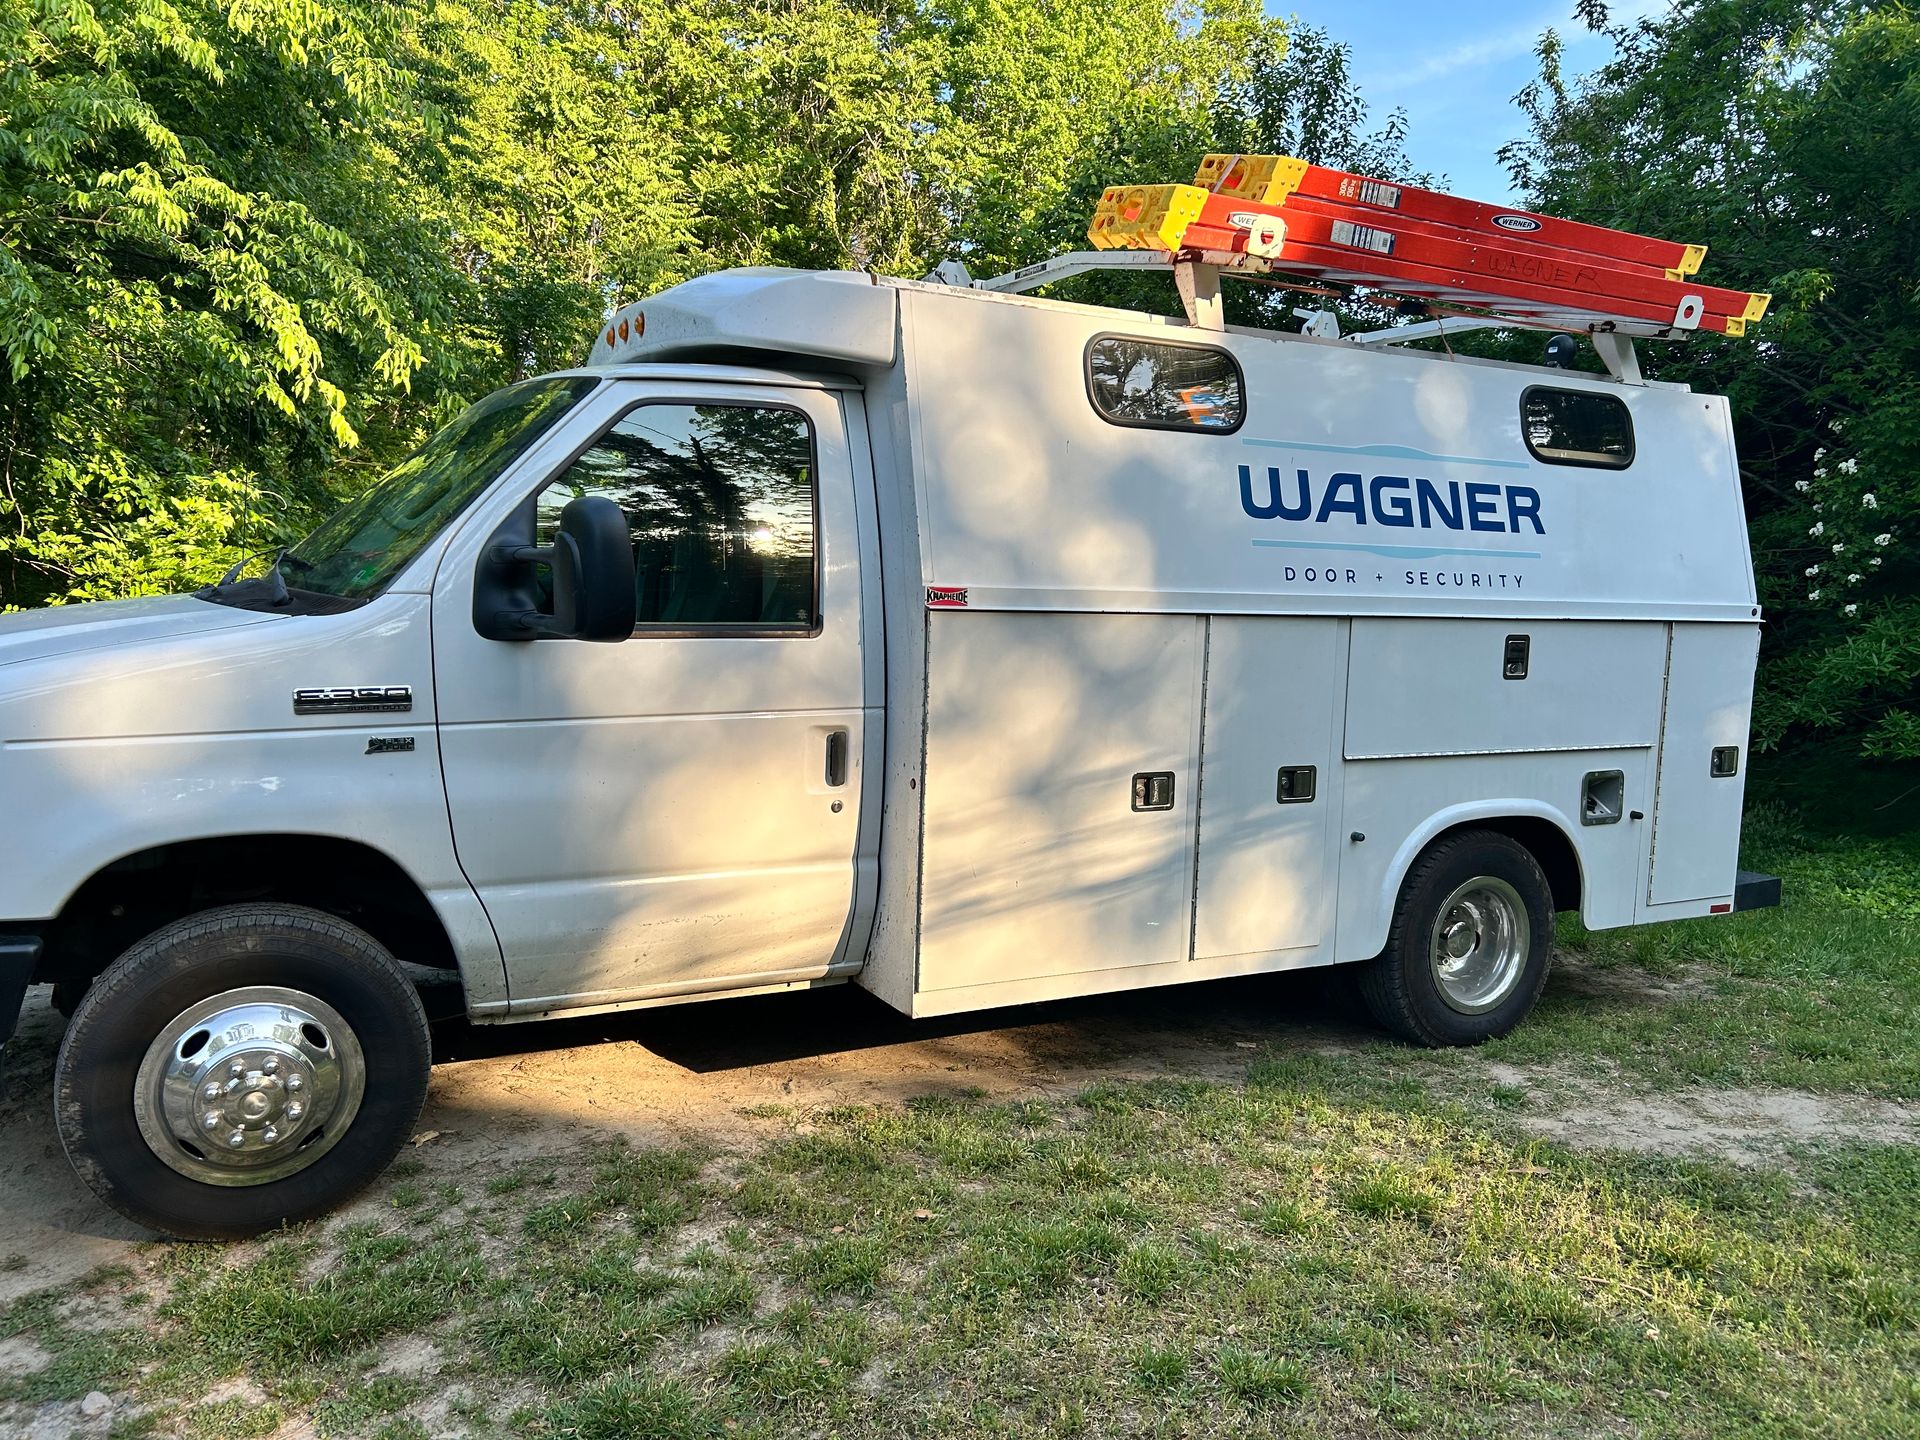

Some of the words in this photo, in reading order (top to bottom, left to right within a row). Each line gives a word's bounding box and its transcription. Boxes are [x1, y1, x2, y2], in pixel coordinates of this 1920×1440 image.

[1502, 218, 1533, 229] WERNER
[1488, 255, 1604, 293] WAGNER
[1237, 464, 1547, 536] WAGNER
[1284, 566, 1357, 584] DOOR
[1375, 571, 1384, 582] +
[1405, 570, 1525, 589] SECURITY
[926, 588, 968, 604] KNAPHEIDE
[347, 704, 379, 713] SUPER
[382, 703, 410, 712] DUTY
